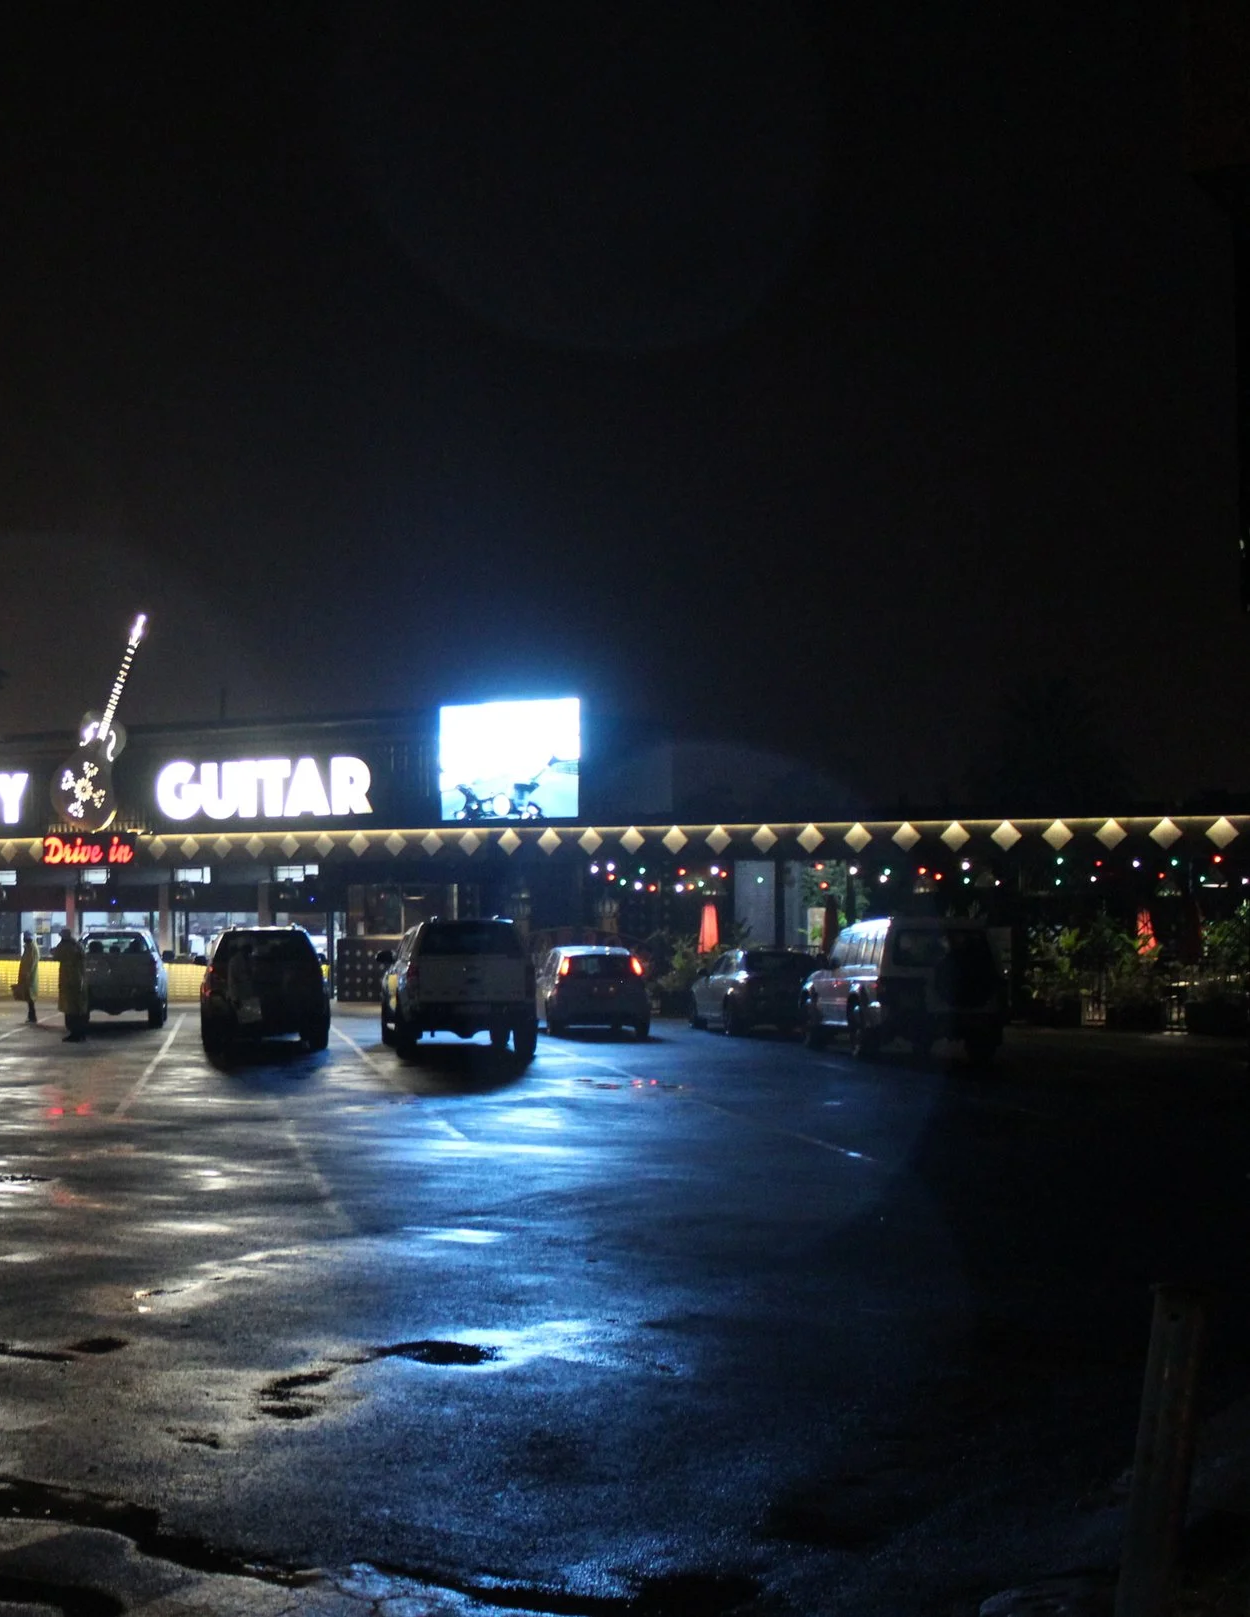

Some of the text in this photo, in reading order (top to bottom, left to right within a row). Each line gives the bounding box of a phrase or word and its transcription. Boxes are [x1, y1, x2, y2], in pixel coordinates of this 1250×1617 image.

[155, 756, 374, 822] GUITAR
[43, 836, 134, 865] Drive in
